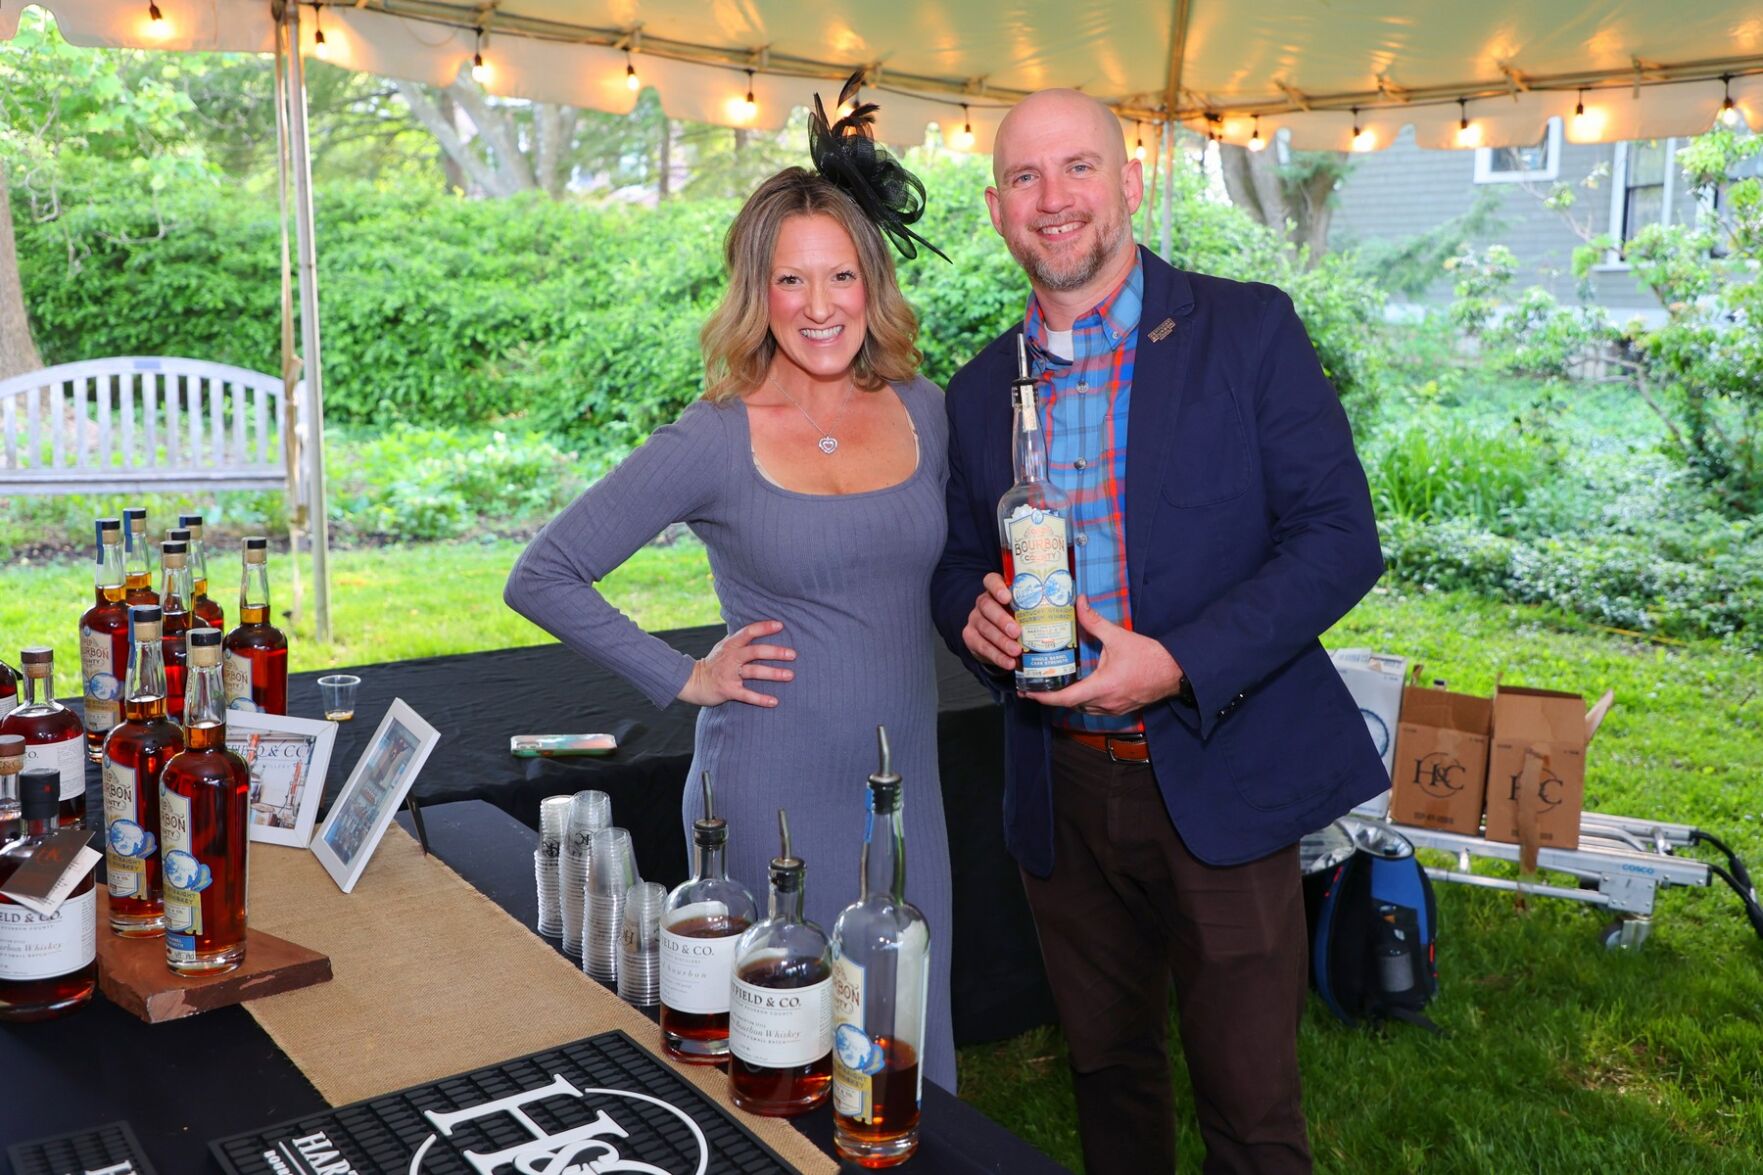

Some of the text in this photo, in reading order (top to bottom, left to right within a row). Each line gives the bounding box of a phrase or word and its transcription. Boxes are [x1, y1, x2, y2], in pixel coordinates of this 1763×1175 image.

[1014, 535, 1065, 556] BOURBON
[1024, 552, 1056, 561] COUNTY
[1622, 864, 1655, 876] COSCO
[25, 912, 34, 923] &
[682, 944, 690, 954] &
[693, 945, 715, 956] CO.
[766, 996, 775, 1008] &
[779, 997, 802, 1008] CO.
[292, 1131, 359, 1175] HAR
